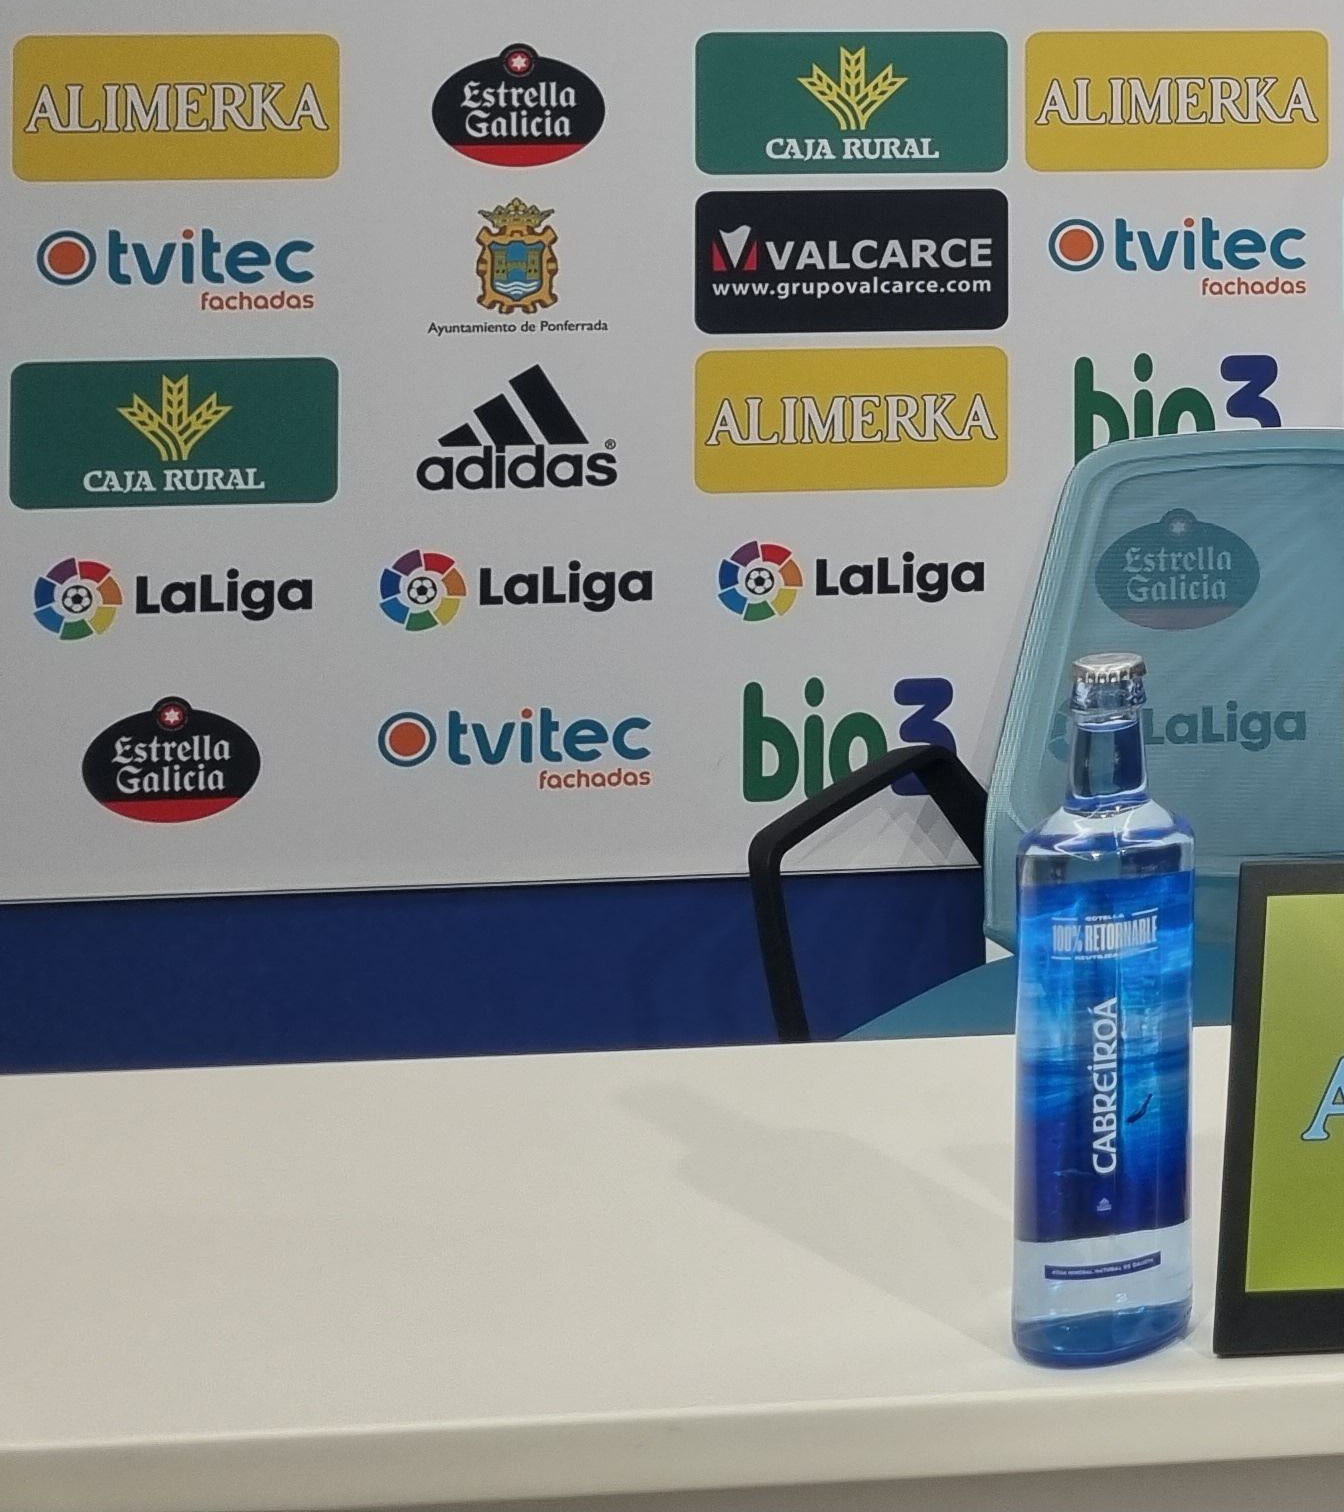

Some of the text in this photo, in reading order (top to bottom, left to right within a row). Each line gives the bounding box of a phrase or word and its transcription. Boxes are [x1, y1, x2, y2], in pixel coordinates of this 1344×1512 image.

[23, 82, 329, 134] ALIMERKA
[461, 81, 576, 108] Estrella
[1034, 77, 1319, 125] ALIMERKA
[466, 110, 570, 137] Galicia
[766, 138, 939, 160] CAJA RURAL
[109, 229, 314, 285] tvitec
[766, 238, 992, 270] VALCARCE
[1116, 218, 1305, 271] tvitec
[202, 291, 313, 310] fachadas
[713, 277, 991, 299] www.grupovalcarce.com
[428, 320, 608, 336] Ayuntamiento de Ponferrada
[704, 393, 998, 446] ALIMERKA
[84, 468, 265, 493] CAJA RURAL
[417, 445, 617, 490] adidas
[1123, 546, 1231, 573] Estrella
[480, 561, 652, 612] LaLiga
[816, 552, 984, 602] LaLiga
[1127, 574, 1226, 602] Galicia
[136, 568, 312, 621] LaLiga
[112, 735, 230, 763] Estrella
[449, 708, 651, 765] tvitec
[117, 764, 224, 793] Galicia
[1052, 915, 1158, 952] 100% RETORNABLE
